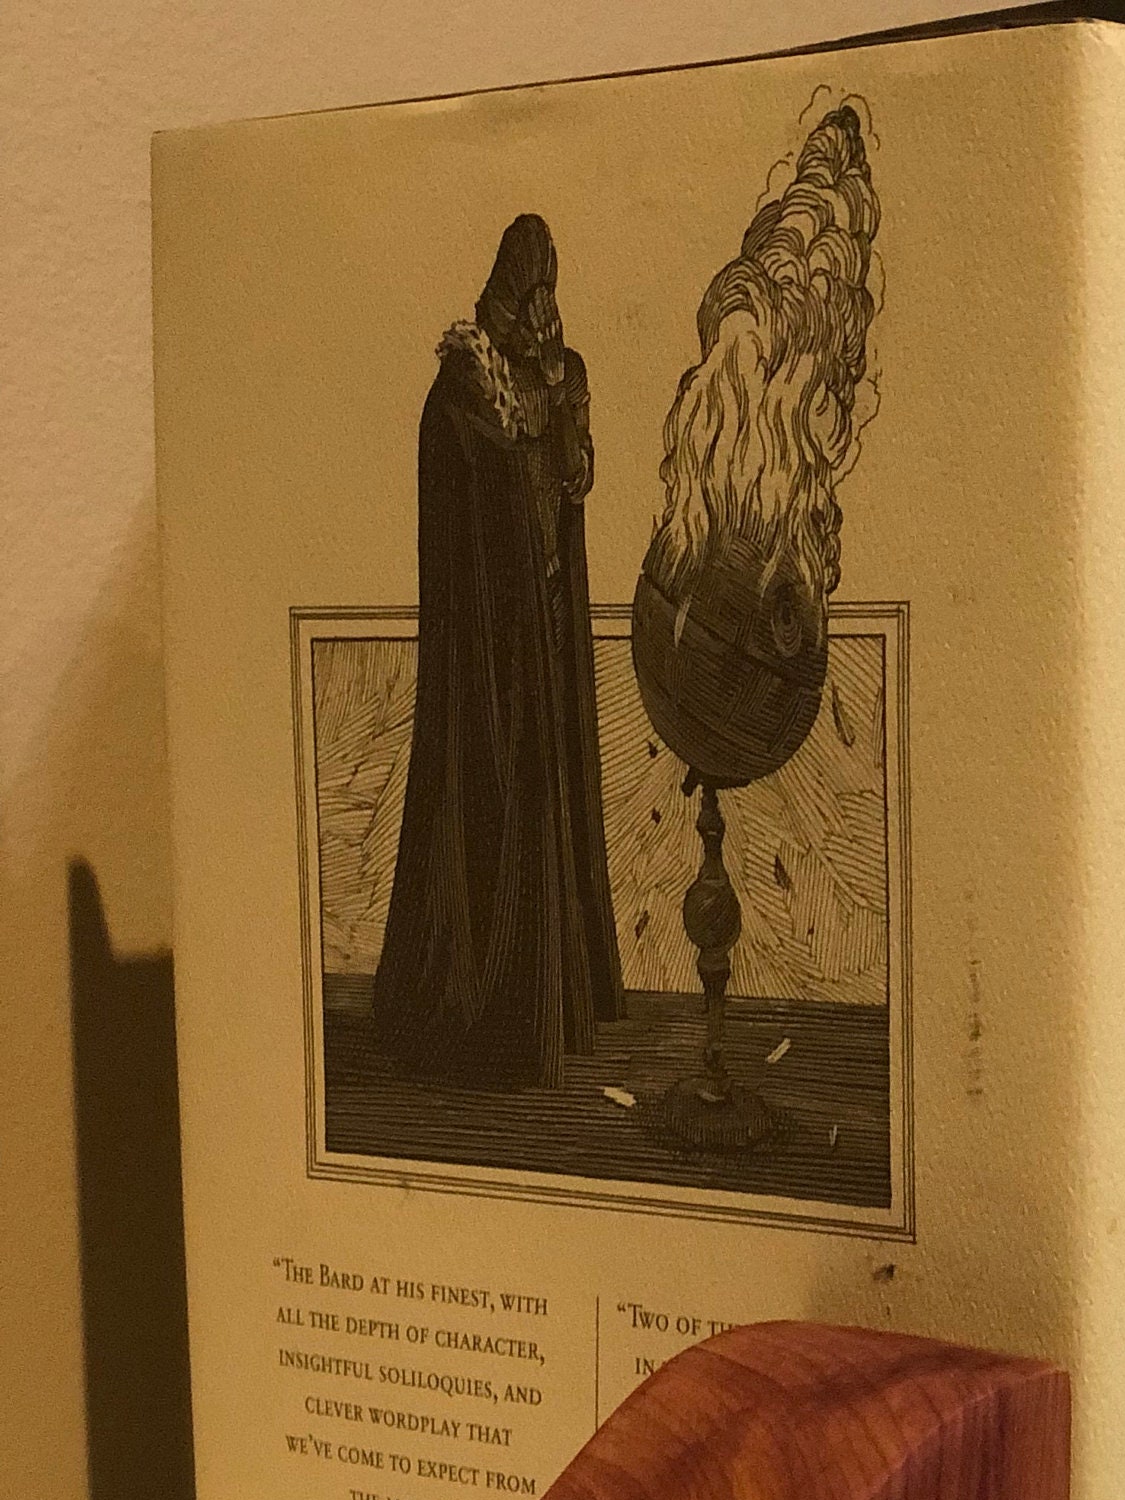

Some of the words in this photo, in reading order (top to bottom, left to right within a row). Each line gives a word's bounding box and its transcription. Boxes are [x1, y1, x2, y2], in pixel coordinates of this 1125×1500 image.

[319, 1263, 364, 1291] BARD
[370, 1277, 390, 1295] AT
[396, 1280, 425, 1300] HIS
[431, 1284, 495, 1314] FINEST,
[500, 1294, 548, 1315] WITH
[276, 1307, 304, 1326] ALL
[309, 1311, 340, 1332] THE
[346, 1317, 399, 1340] DEPTH
[406, 1325, 429, 1344] OF
[435, 1329, 545, 1366] CHARACTER,
[676, 1317, 701, 1335] OF
[279, 1349, 373, 1380] INSIGHTFUL
[379, 1365, 498, 1404] SOLILOQUIES,
[504, 1383, 542, 1406] AND
[305, 1396, 363, 1422] CLEVER
[369, 1407, 460, 1438] WORDPLAY
[466, 1423, 512, 1446] THAT
[286, 1433, 332, 1459] WE'VE
[338, 1445, 384, 1469] COME
[389, 1454, 411, 1474] TO
[417, 1459, 480, 1486] EXPECT
[486, 1470, 536, 1495] FROM
